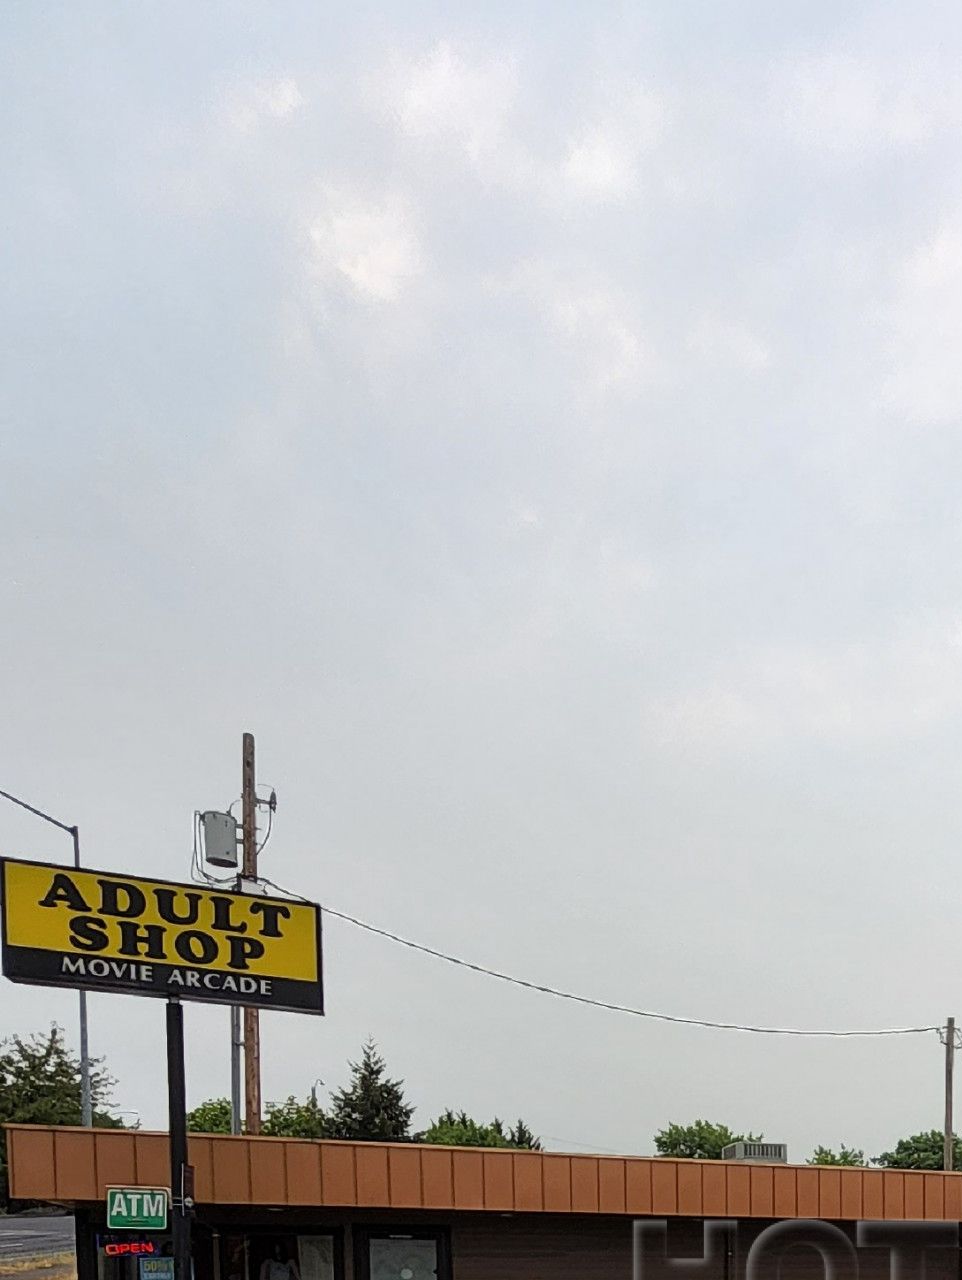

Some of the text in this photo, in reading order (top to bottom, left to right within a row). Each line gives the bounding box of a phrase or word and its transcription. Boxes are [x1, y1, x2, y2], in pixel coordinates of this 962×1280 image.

[38, 874, 290, 938] ADULT
[68, 916, 265, 970] SHOP
[61, 956, 273, 996] MOVIE ARCADE
[111, 1194, 164, 1217] ATM
[105, 1242, 154, 1255] OPEN
